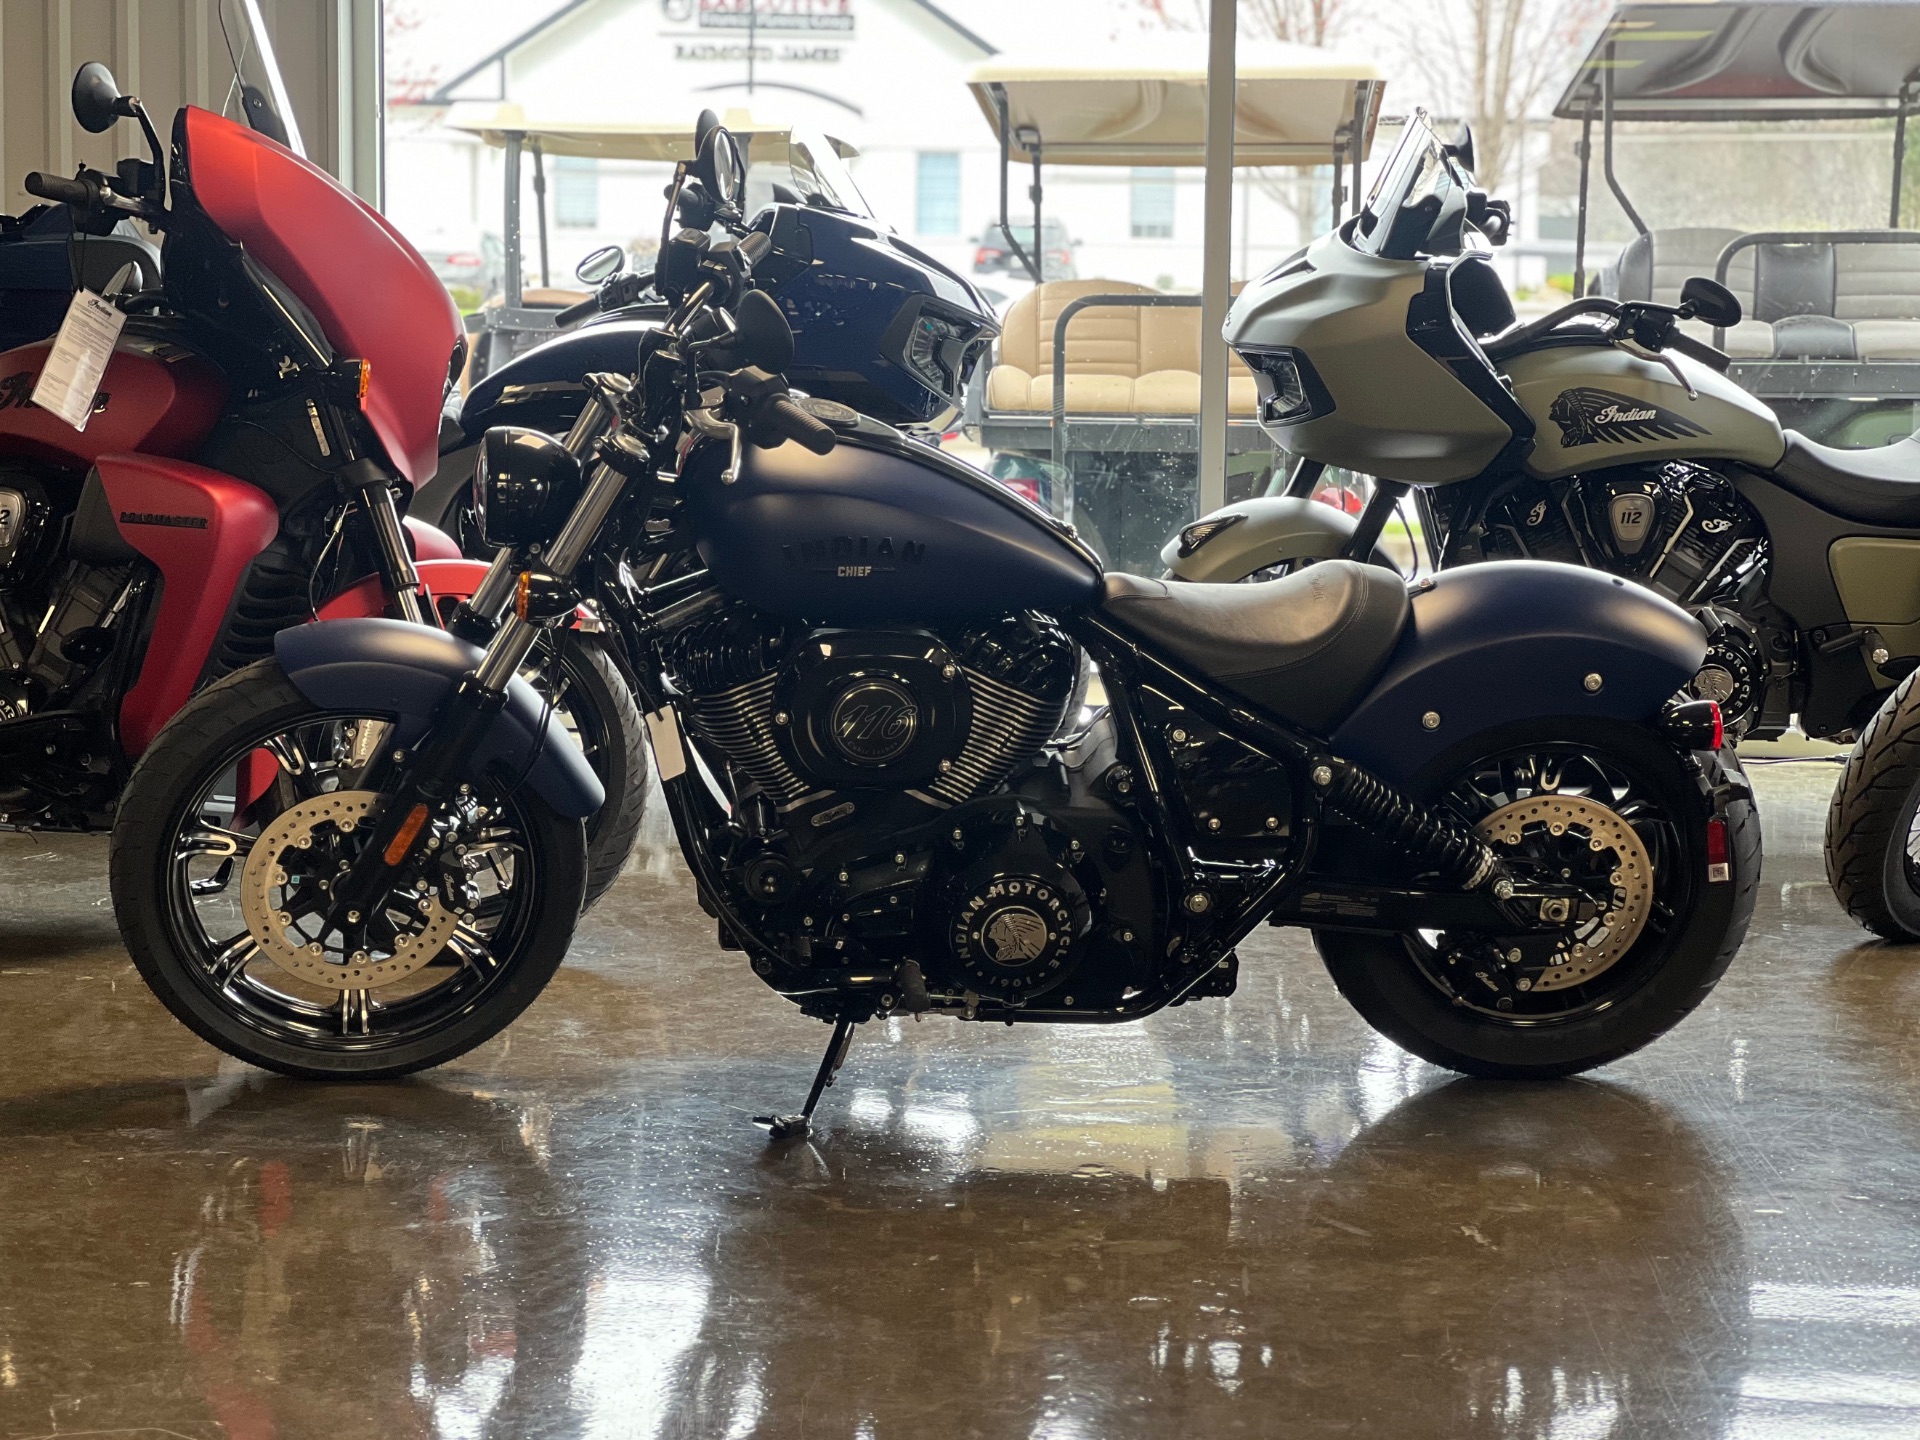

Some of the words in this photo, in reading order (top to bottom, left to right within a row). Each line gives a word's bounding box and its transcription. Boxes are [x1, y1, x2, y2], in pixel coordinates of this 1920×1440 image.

[1594, 405, 1657, 424] Indian
[1620, 511, 1642, 524] 112
[781, 535, 928, 568] INDIAN
[837, 565, 872, 578] CHIEF
[1706, 646, 1751, 708] OTORCYCLE
[835, 704, 918, 740] 116
[955, 895, 985, 968] INDIAN
[986, 881, 1072, 969] MOTORCYCLE
